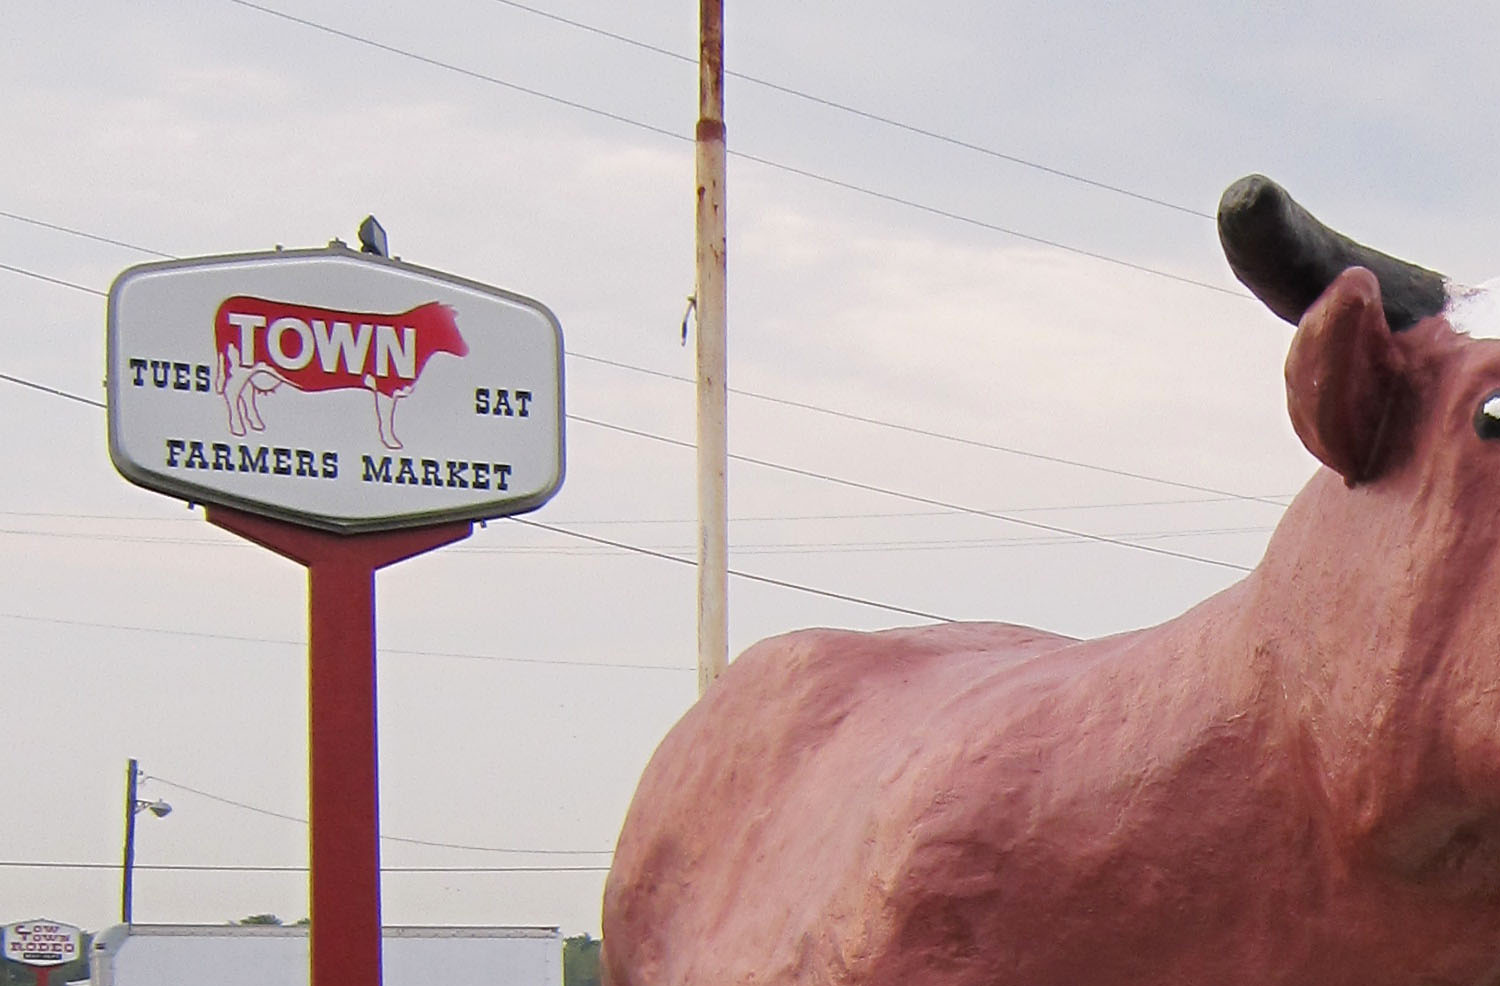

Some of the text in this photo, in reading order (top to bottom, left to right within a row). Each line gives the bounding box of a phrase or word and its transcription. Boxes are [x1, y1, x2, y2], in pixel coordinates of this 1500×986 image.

[228, 312, 416, 379] TOWN
[129, 358, 211, 392] TUES
[476, 388, 532, 417] SAT
[166, 439, 512, 490] FARMERS MARKET
[11, 942, 75, 953] RODEO
